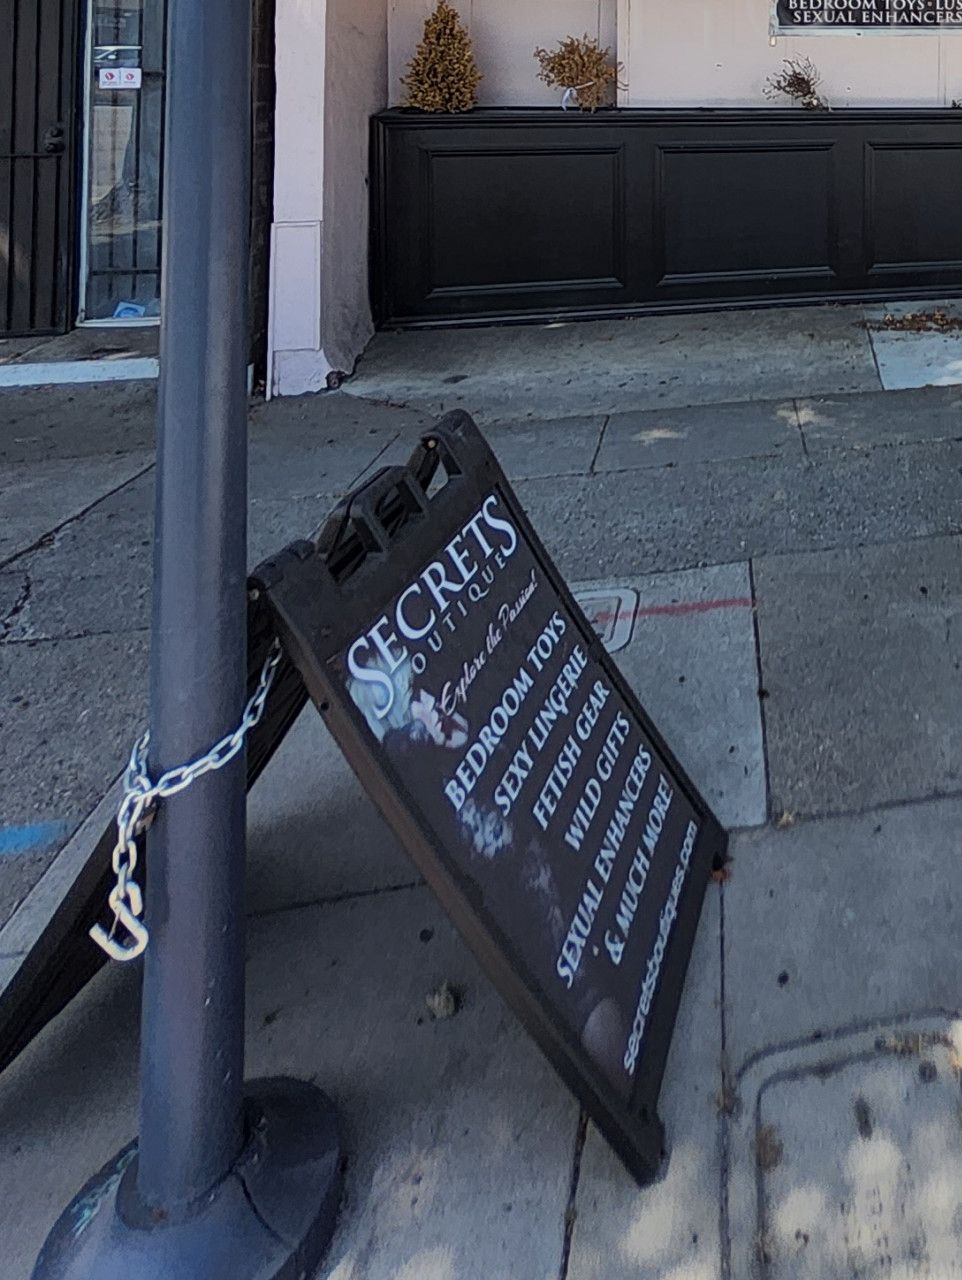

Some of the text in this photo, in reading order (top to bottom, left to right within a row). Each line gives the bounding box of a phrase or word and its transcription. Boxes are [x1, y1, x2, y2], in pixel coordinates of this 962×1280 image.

[793, 10, 857, 23] SEXUAL
[347, 495, 519, 720] SECRETS
[411, 552, 507, 674] OUTIQUE
[441, 568, 538, 716] Explore the Passion!
[444, 611, 567, 812] BEDROOM TOYS
[494, 644, 588, 817] SEXY LINGERIE
[532, 680, 611, 832] FETISH GEAR
[564, 710, 630, 851] WILD GIFTS
[556, 744, 651, 990] SEXUAL ENHANCERS
[604, 773, 674, 966] & MUCH MORE!
